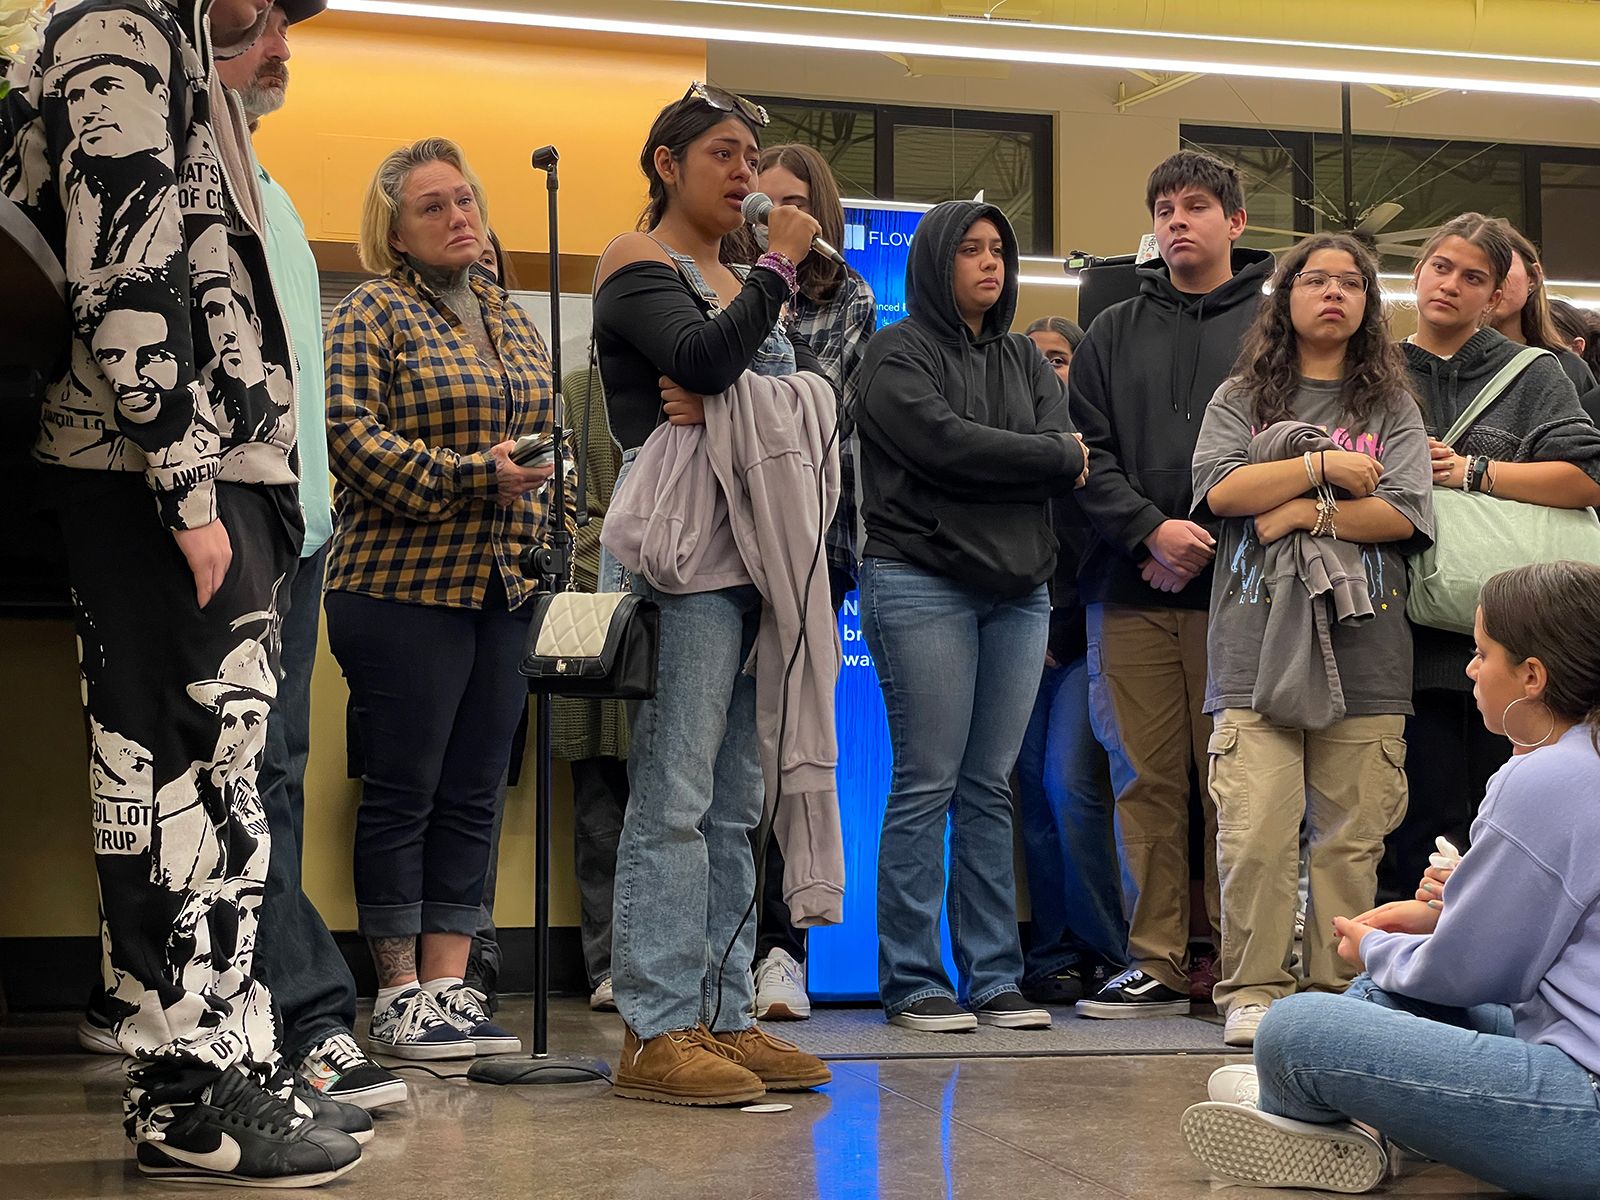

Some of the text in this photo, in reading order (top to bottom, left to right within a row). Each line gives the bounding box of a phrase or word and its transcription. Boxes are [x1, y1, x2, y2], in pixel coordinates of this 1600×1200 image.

[178, 188, 200, 209] OF
[876, 302, 900, 312] nced
[843, 654, 875, 667] wa
[116, 805, 152, 826] LOT
[210, 1036, 234, 1060] OF
